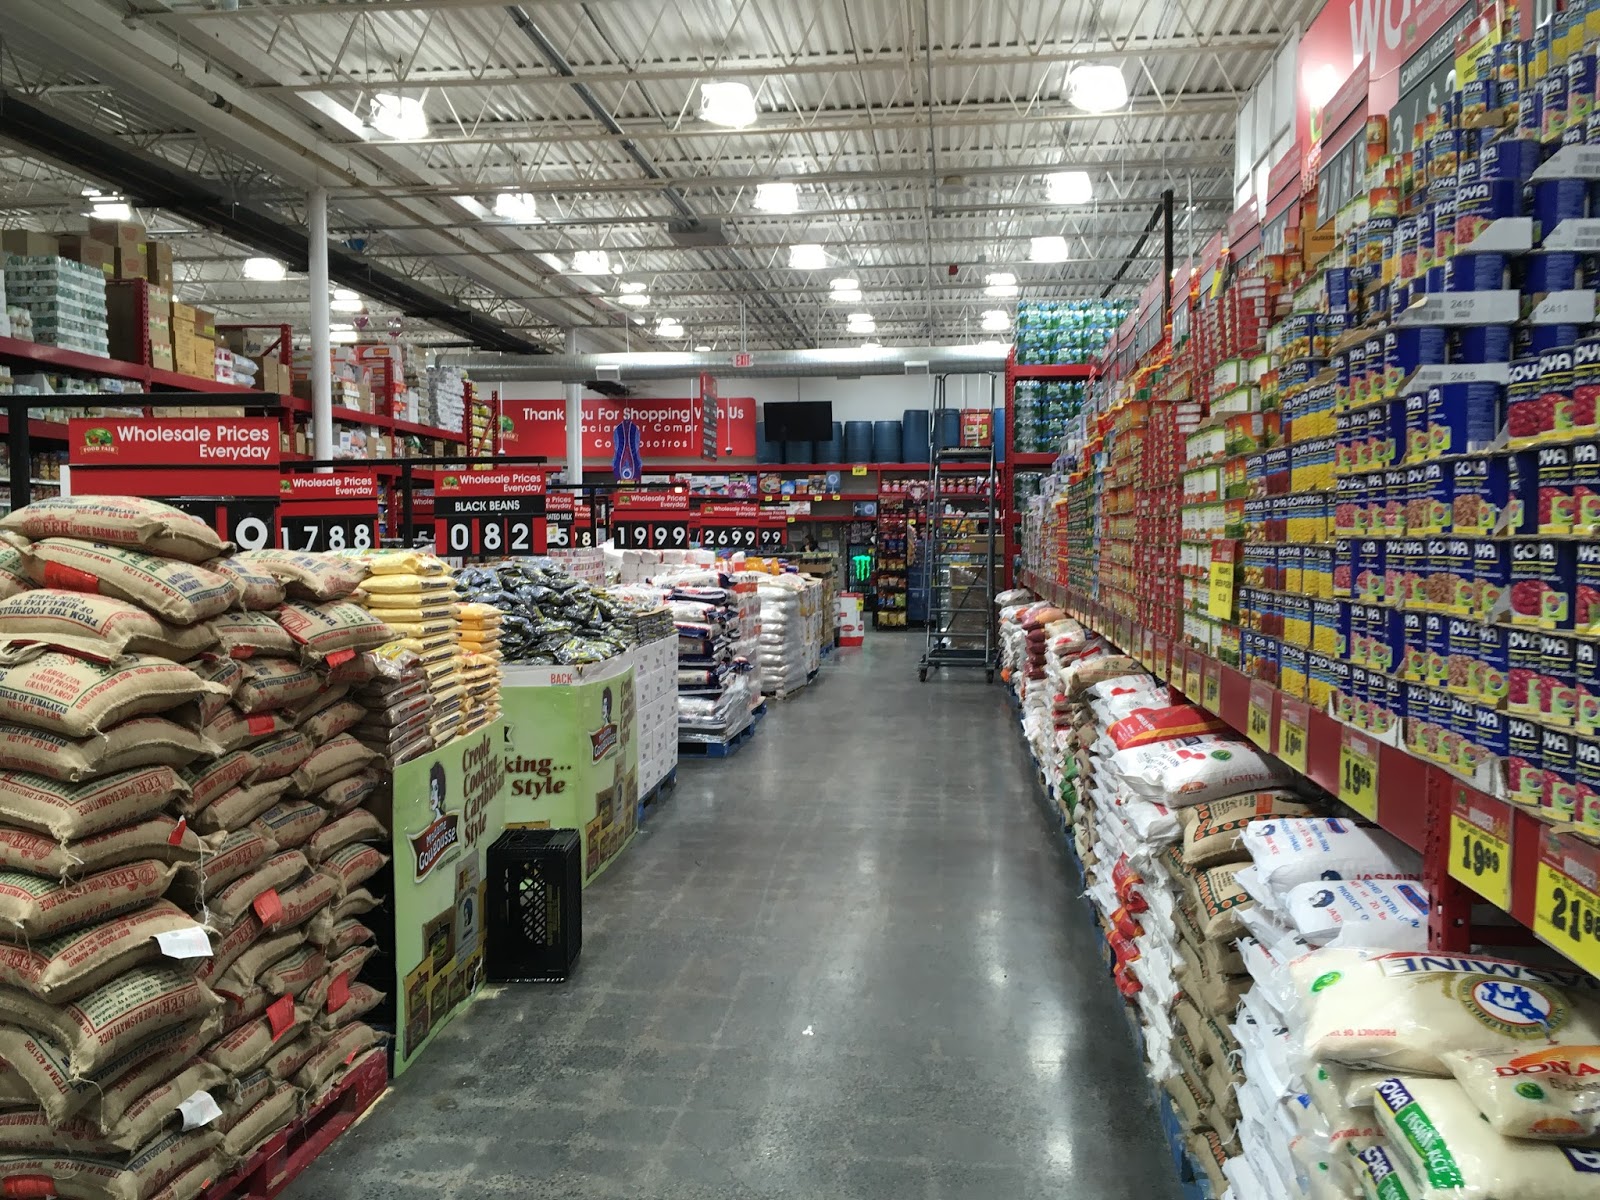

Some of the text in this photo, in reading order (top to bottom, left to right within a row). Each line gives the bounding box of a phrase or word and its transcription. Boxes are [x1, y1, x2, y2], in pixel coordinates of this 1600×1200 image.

[1402, 50, 1430, 88] CANNED
[1458, 180, 1489, 198] OYA
[736, 354, 750, 366] EXIT
[523, 406, 744, 422] Thank ou For Shopping Us
[117, 426, 270, 442] Wholesale Prices
[200, 444, 270, 460] Everyday
[292, 477, 372, 488] Wholesale Prices
[460, 474, 542, 484] Wholesale Prices
[336, 487, 373, 496] Everyday
[504, 484, 542, 493] Everyday
[455, 500, 520, 512] BLACK BEANS
[546, 502, 572, 510] Everyday
[561, 512, 572, 520] MILK
[74, 524, 138, 540] PURE BASMATI RICE
[618, 526, 686, 546] 1999
[705, 530, 756, 545] 2699
[762, 531, 781, 544] 99
[123, 566, 154, 582] 421126
[161, 586, 184, 602] ITEM
[22, 600, 79, 610] HIMALAYAS
[47, 606, 68, 616] THE
[80, 604, 94, 614] OF
[68, 610, 99, 628] FROM
[30, 672, 80, 694] SABOR PROPIO
[65, 674, 80, 686] CON
[550, 674, 573, 685] BACK
[24, 680, 74, 701] GRANO LARGO
[7, 700, 62, 720] NET WT 20 LBS
[18, 694, 68, 714] OF HIMALAYAS
[7, 734, 22, 743] NET
[34, 740, 44, 748] 20
[44, 743, 60, 753] LBS
[462, 733, 490, 773] Creole
[1223, 774, 1264, 787] JASMINE
[511, 778, 566, 800] Style
[76, 784, 136, 816] PURE BASMATI RICE
[426, 820, 447, 847] Madame
[465, 811, 487, 849] Style
[88, 878, 106, 895] PURE
[38, 895, 56, 912] RICE
[1336, 886, 1362, 912] PRODUCT
[1369, 900, 1380, 910] 20
[1380, 895, 1399, 916] EXTRA
[98, 998, 160, 1047] PURE BASMATI RICE
[1462, 997, 1512, 1034] ELEPHANT
[24, 1040, 47, 1065] 421126
[50, 1072, 70, 1095] ITEM
[1427, 1148, 1449, 1175] RICE
[95, 1167, 122, 1180] ITEM
